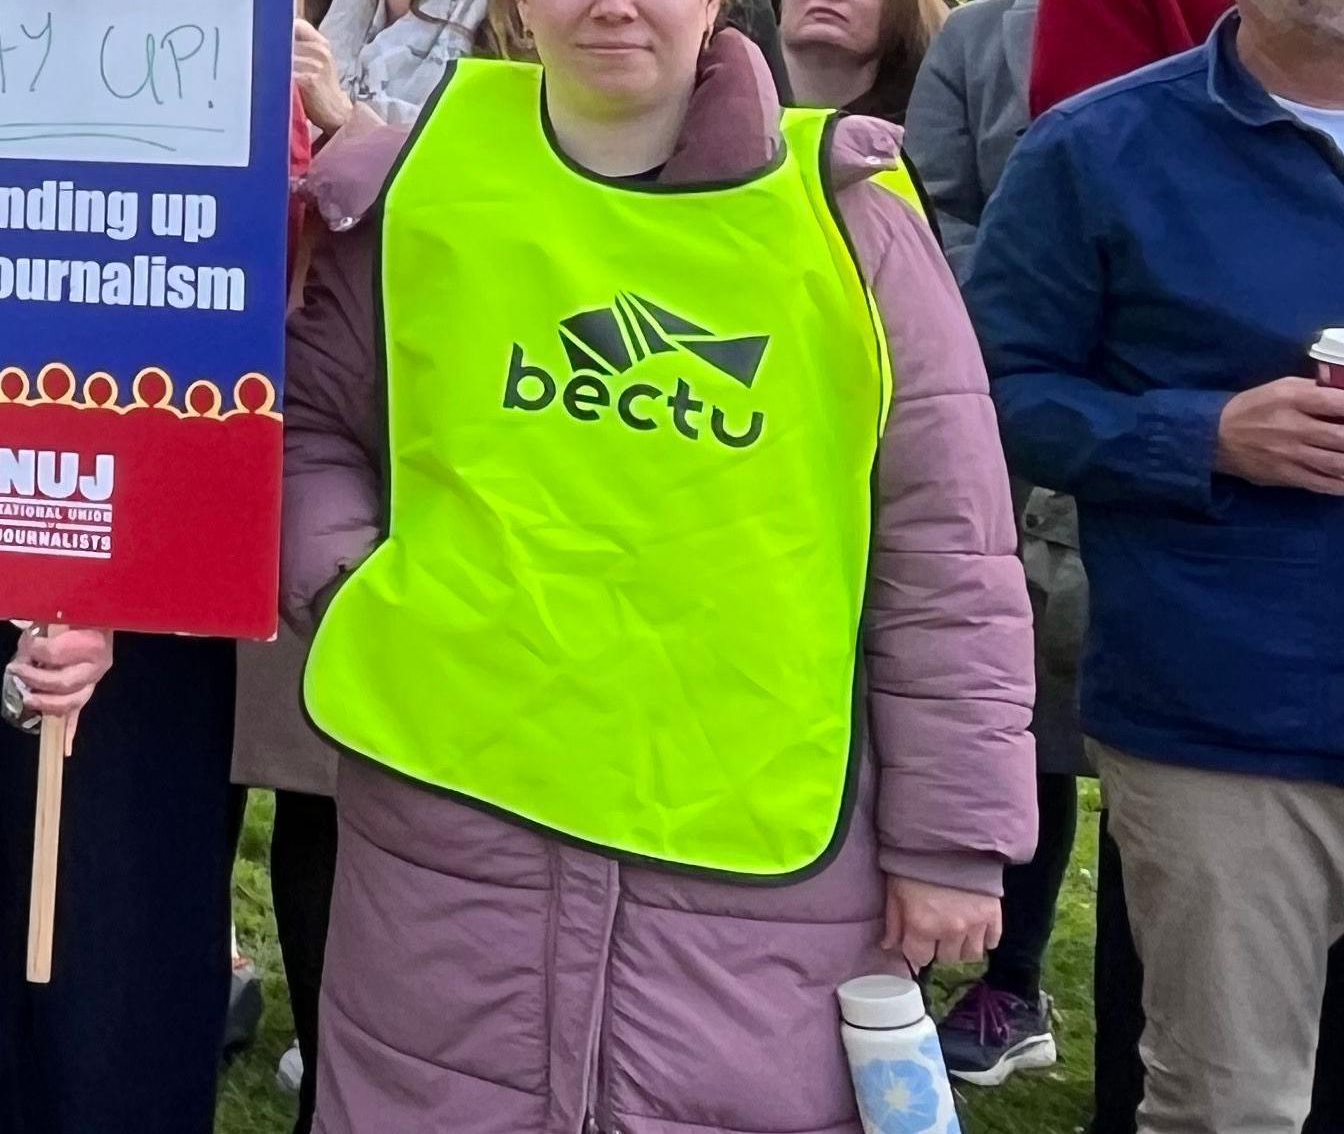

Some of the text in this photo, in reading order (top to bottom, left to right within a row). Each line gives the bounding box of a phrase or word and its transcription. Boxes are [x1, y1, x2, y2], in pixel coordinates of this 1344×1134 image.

[99, 24, 221, 109] UP!
[151, 193, 217, 243] up
[503, 341, 764, 449] bectu
[67, 509, 113, 523] UNION
